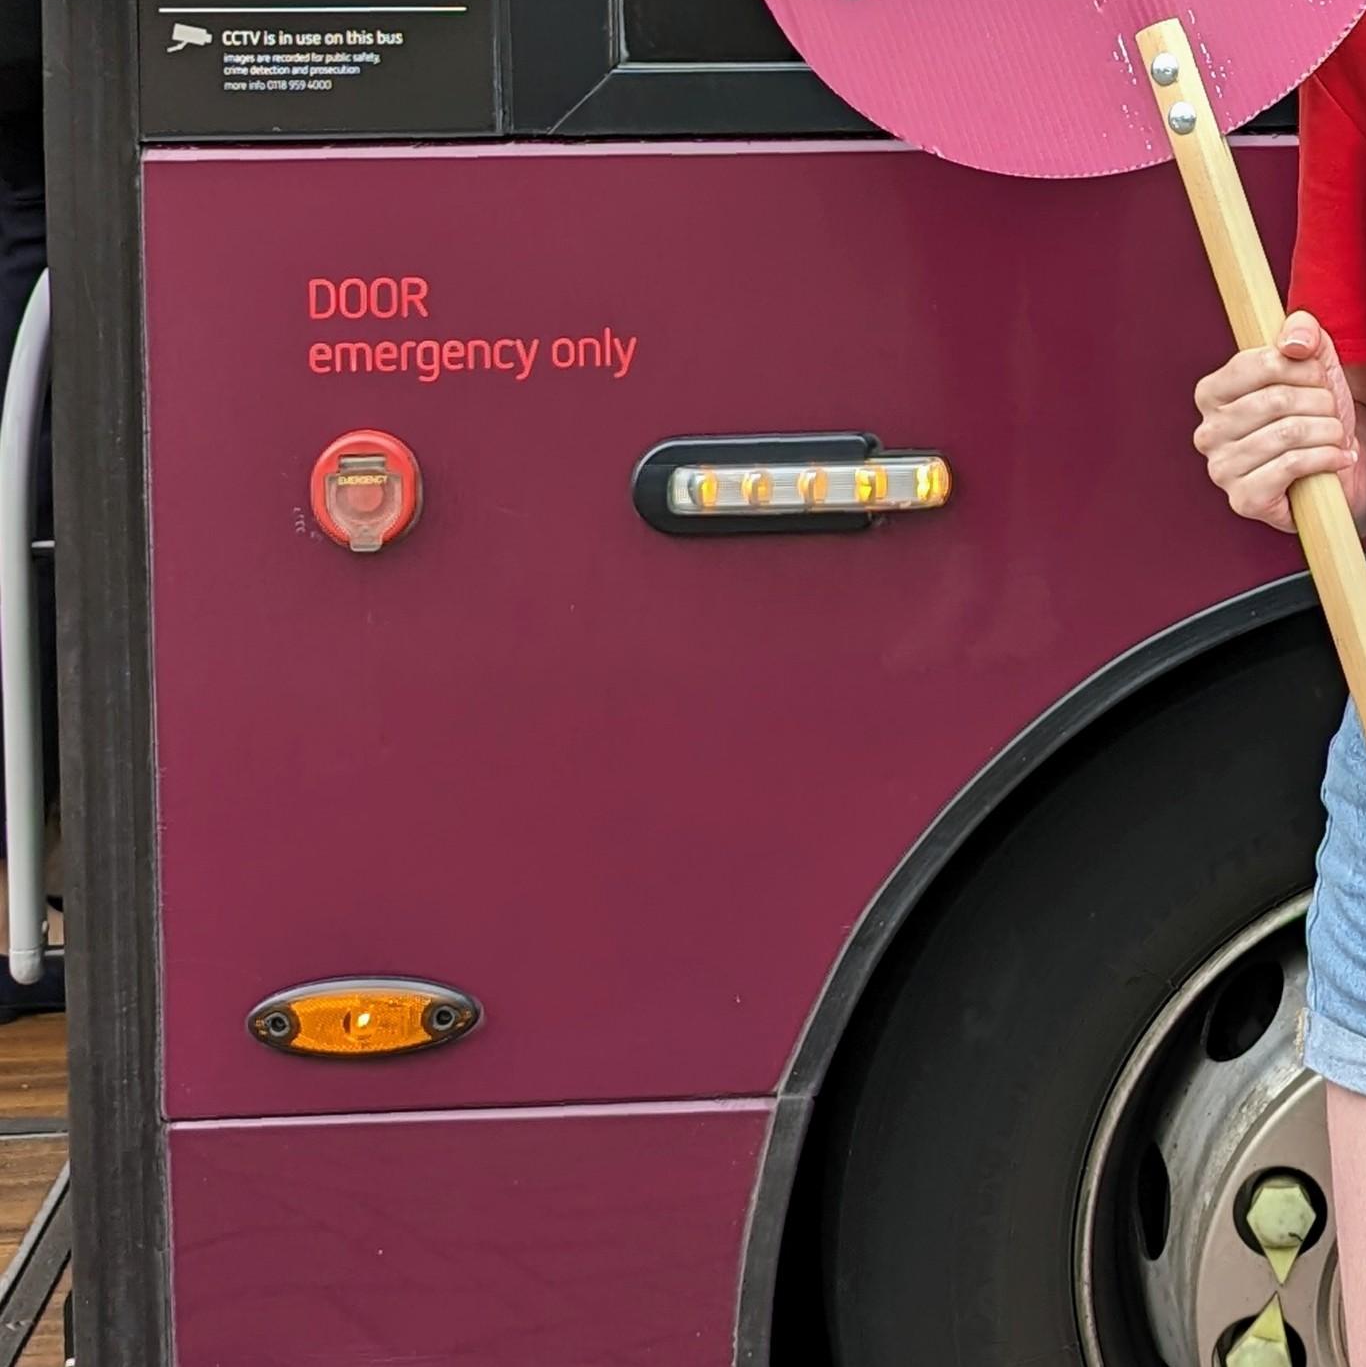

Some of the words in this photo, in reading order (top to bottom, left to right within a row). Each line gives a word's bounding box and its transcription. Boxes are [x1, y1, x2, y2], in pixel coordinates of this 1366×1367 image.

[222, 31, 261, 45] CCTV
[263, 31, 276, 45] is
[278, 31, 293, 45] in
[296, 33, 321, 46] use
[324, 33, 344, 45] on
[346, 30, 374, 45] this
[376, 31, 403, 45] bus
[224, 53, 255, 64] images
[256, 54, 270, 63] are
[272, 53, 309, 63] recorded
[311, 53, 324, 63] for
[325, 52, 351, 64] public
[224, 65, 248, 75] crime
[251, 65, 290, 75] detection
[292, 65, 308, 75] and
[310, 65, 360, 76] prosecution
[224, 81, 247, 90] more
[249, 80, 265, 90] info
[289, 80, 305, 91] 959
[307, 80, 332, 91] 4000
[309, 277, 428, 319] DOOR
[309, 339, 539, 382] emergency
[551, 327, 636, 378] only
[337, 475, 388, 485] EMERGENCY
